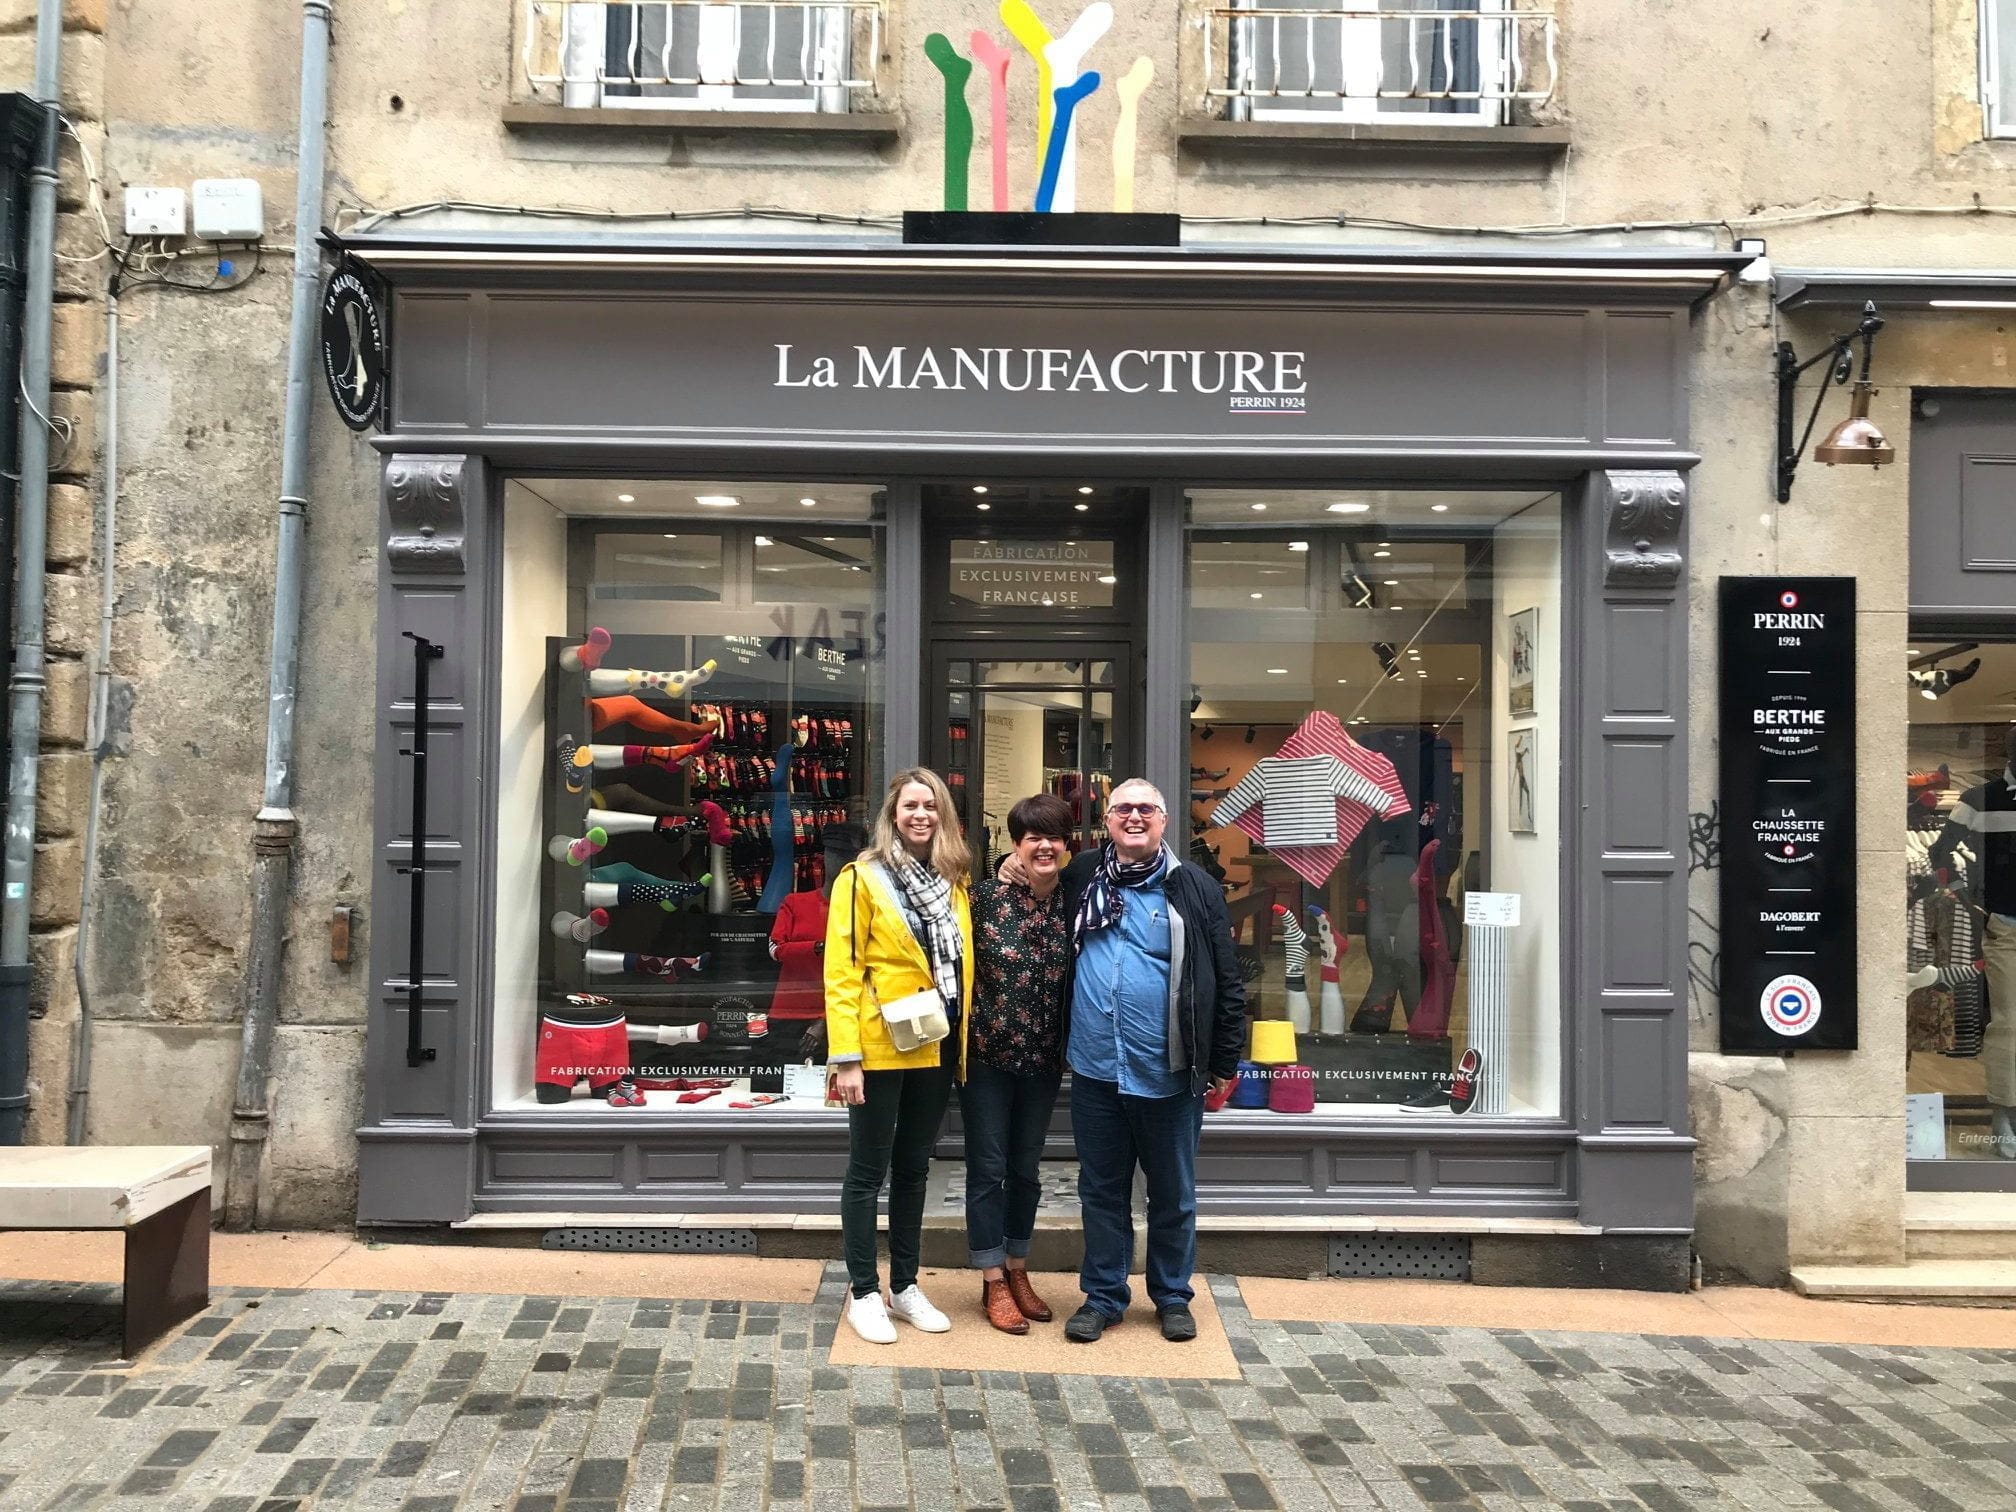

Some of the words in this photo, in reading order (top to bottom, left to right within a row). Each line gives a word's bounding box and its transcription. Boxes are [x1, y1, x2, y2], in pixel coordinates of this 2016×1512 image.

[774, 344, 838, 388] La
[852, 346, 1308, 394] MANUFACTURE
[1230, 397, 1277, 408] PERRIN
[1280, 398, 1306, 408] 1924
[973, 548, 1089, 559] FABRICATION
[960, 570, 1101, 582] EXCLUSIVEMENT
[983, 591, 1078, 604] FRANÇAISE
[1754, 614, 1825, 629] PERRIN
[1778, 636, 1801, 647] 1924
[818, 648, 846, 666] BERTHE
[1754, 710, 1826, 725] BERTHE
[1782, 808, 1796, 818] LA
[1752, 820, 1825, 830] CHAUSSETTE
[1758, 833, 1820, 844] FRANÇAISE
[1760, 912, 1821, 922] DAGOBERT
[717, 1012, 747, 1021] PERRIN
[550, 1066, 635, 1076] FABRICATION
[641, 1066, 744, 1076] EXCLUSIVEMENT
[750, 1066, 782, 1076] FRAN
[1236, 1070, 1320, 1080] FABRICATION
[1325, 1070, 1427, 1081] EXCLUSIVEMENT
